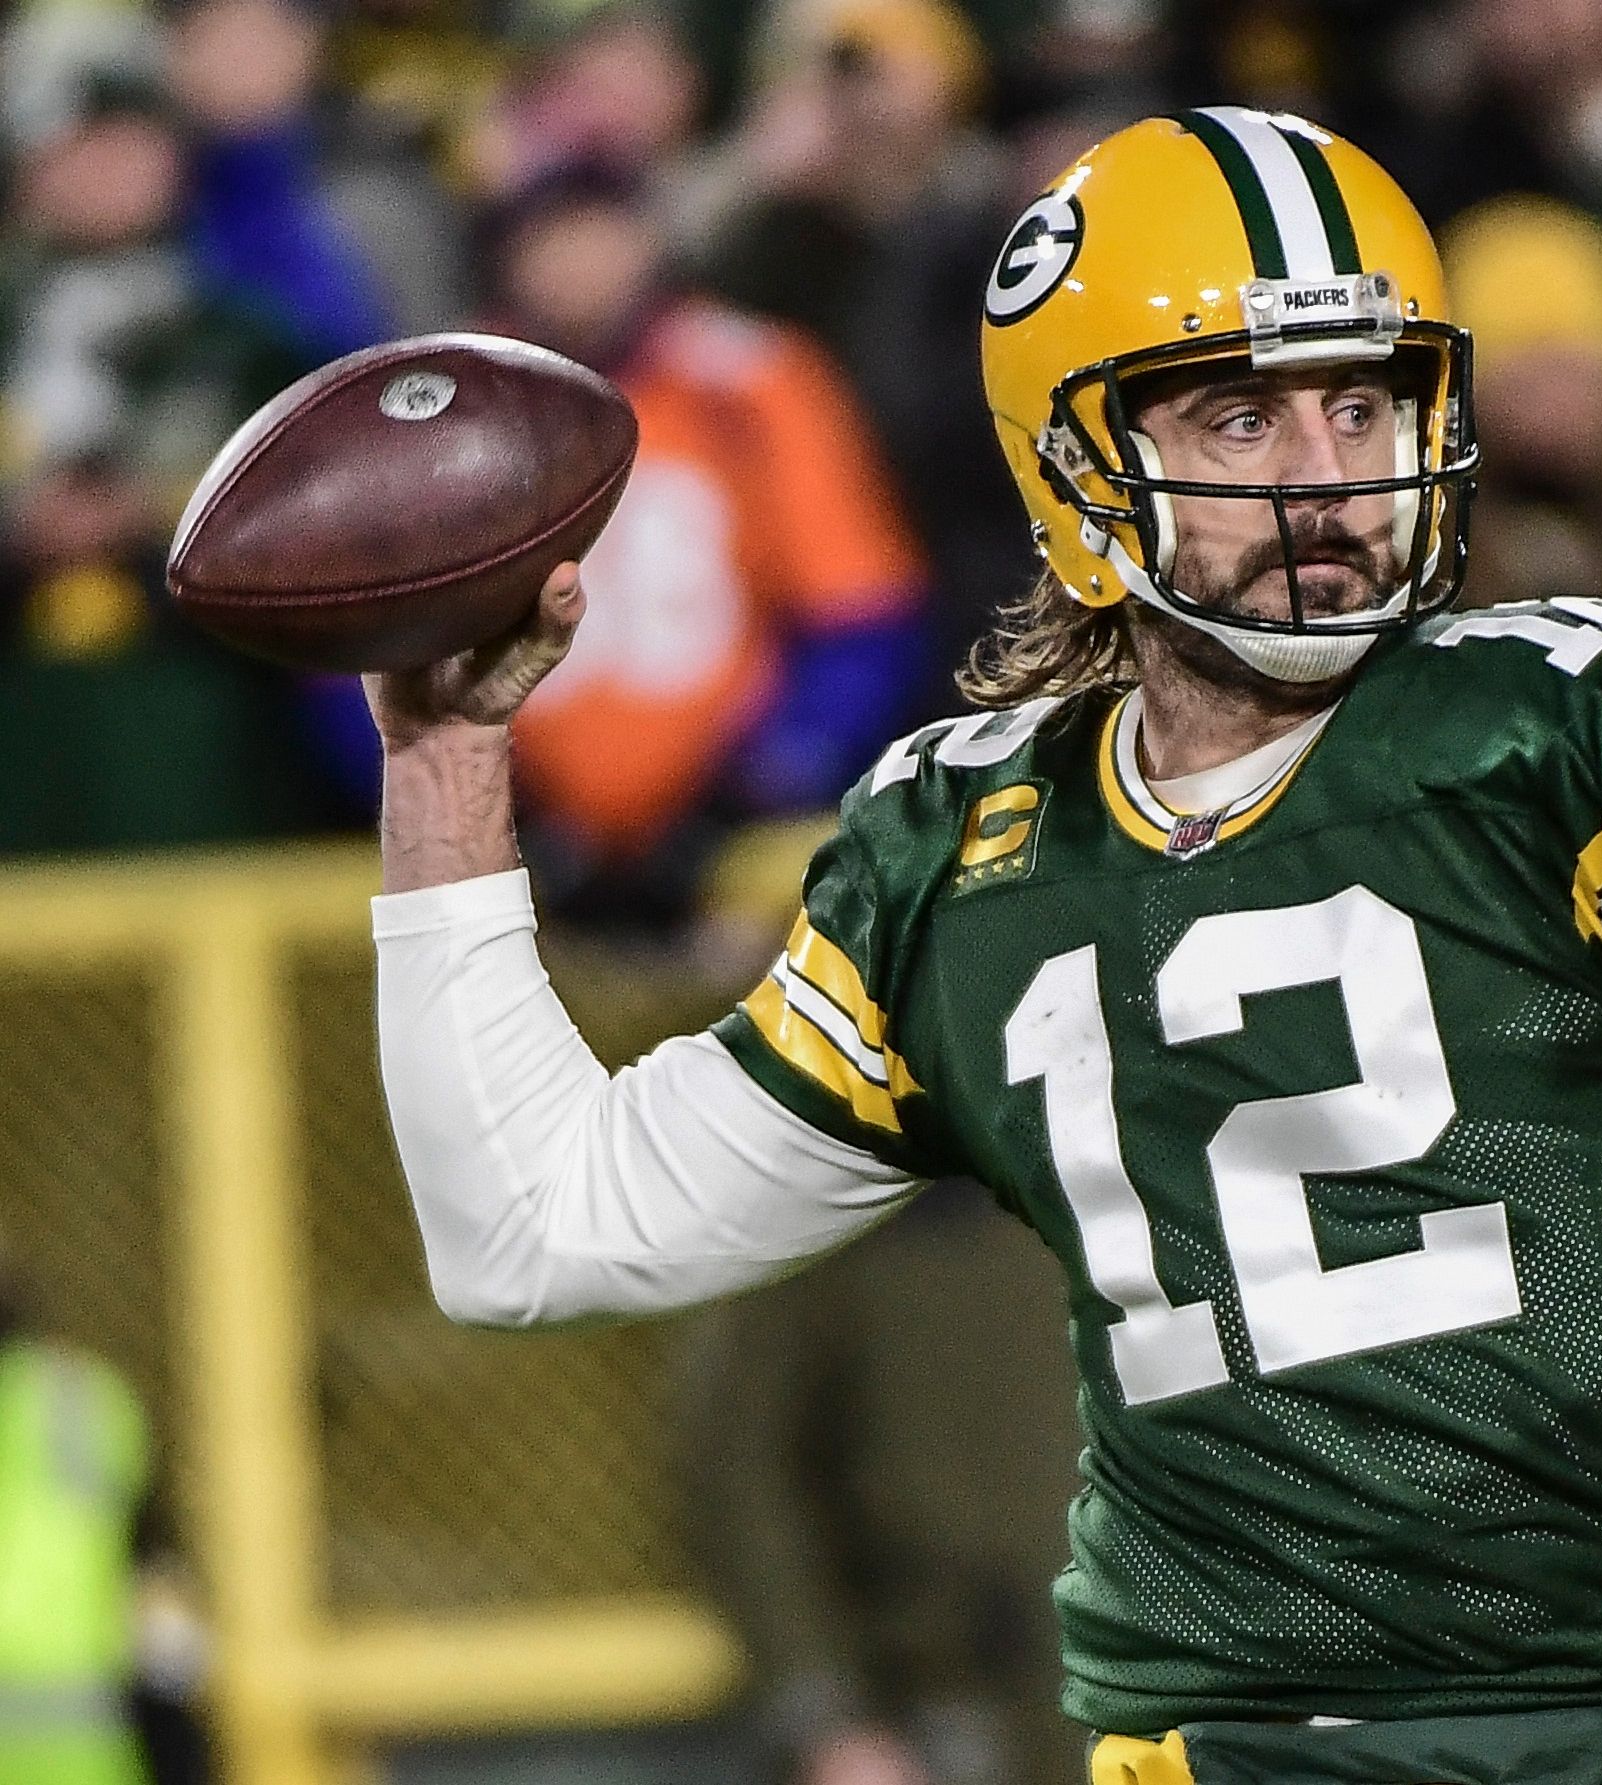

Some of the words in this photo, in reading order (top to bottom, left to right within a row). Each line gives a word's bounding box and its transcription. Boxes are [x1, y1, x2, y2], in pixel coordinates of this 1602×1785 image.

[986, 195, 1078, 317] G
[1283, 288, 1349, 311] PACKERS
[961, 784, 1039, 867] C
[1004, 883, 1523, 1407] 12
